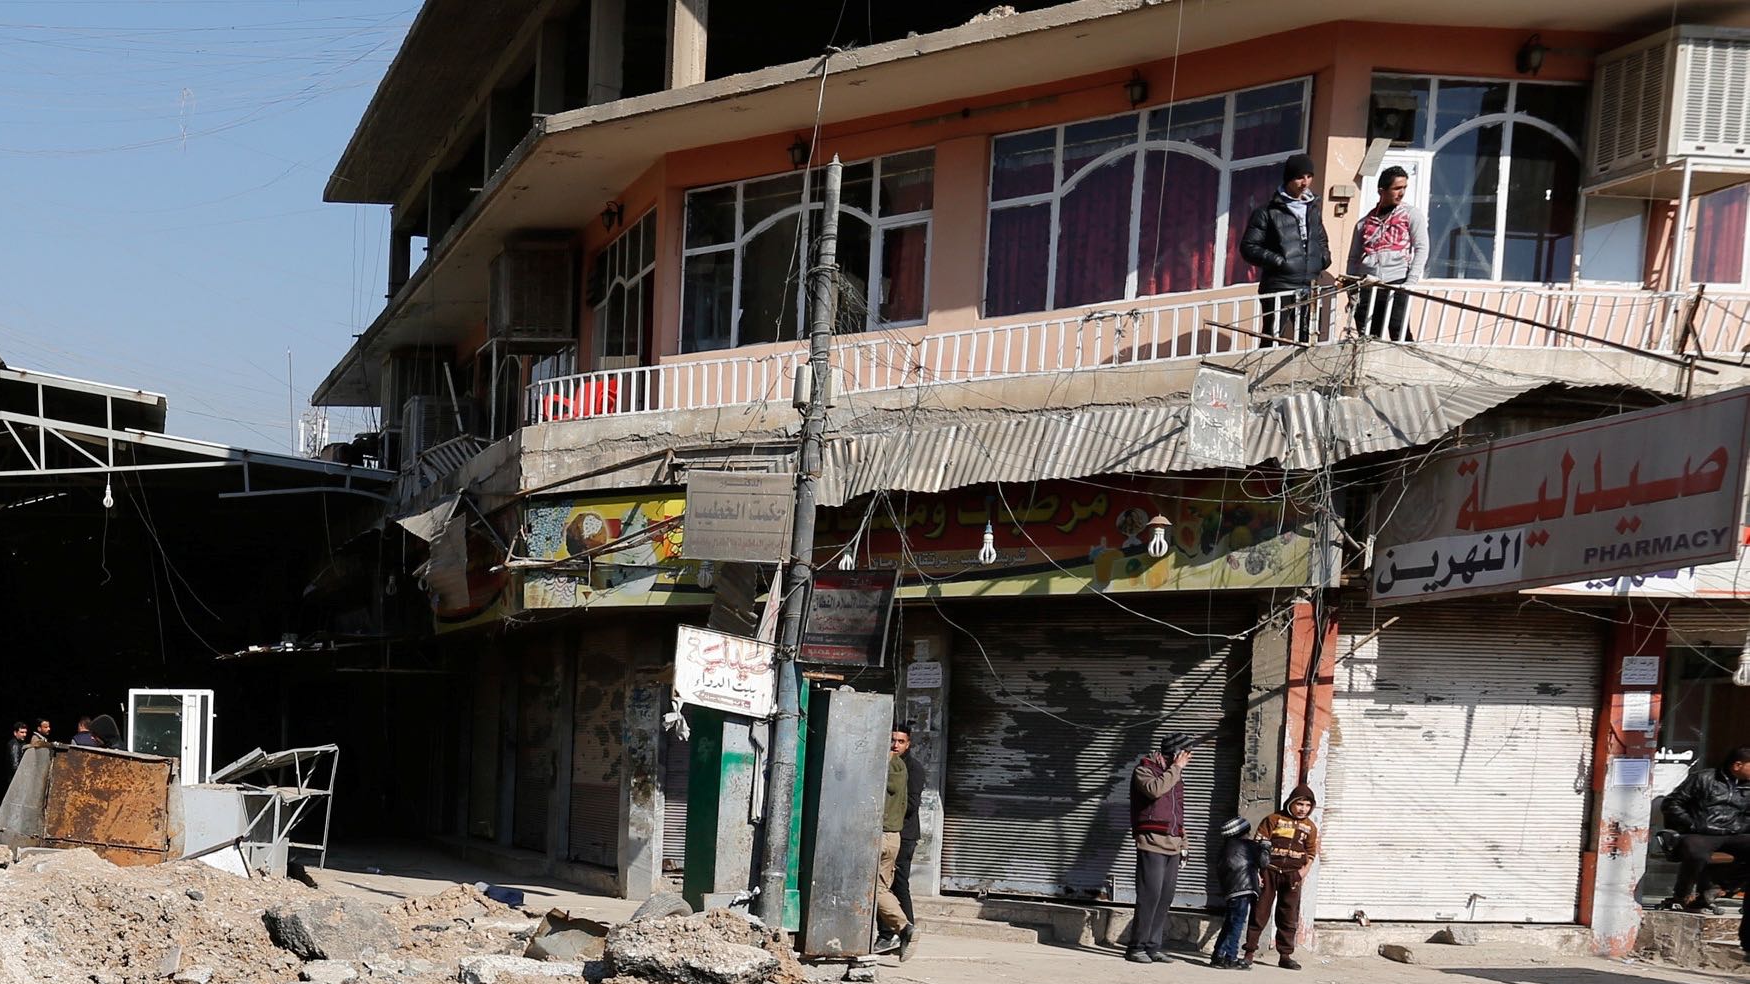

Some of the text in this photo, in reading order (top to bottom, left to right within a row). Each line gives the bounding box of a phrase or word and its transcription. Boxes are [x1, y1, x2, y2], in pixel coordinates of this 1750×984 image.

[1456, 446, 1728, 547] صيدلية
[1376, 528, 1522, 594] النهرين
[1583, 526, 1729, 565] PHARMACY
[686, 635, 771, 681] صيدلية
[694, 671, 758, 699] بيت الدواء
[1654, 746, 1694, 764] صيدلي
